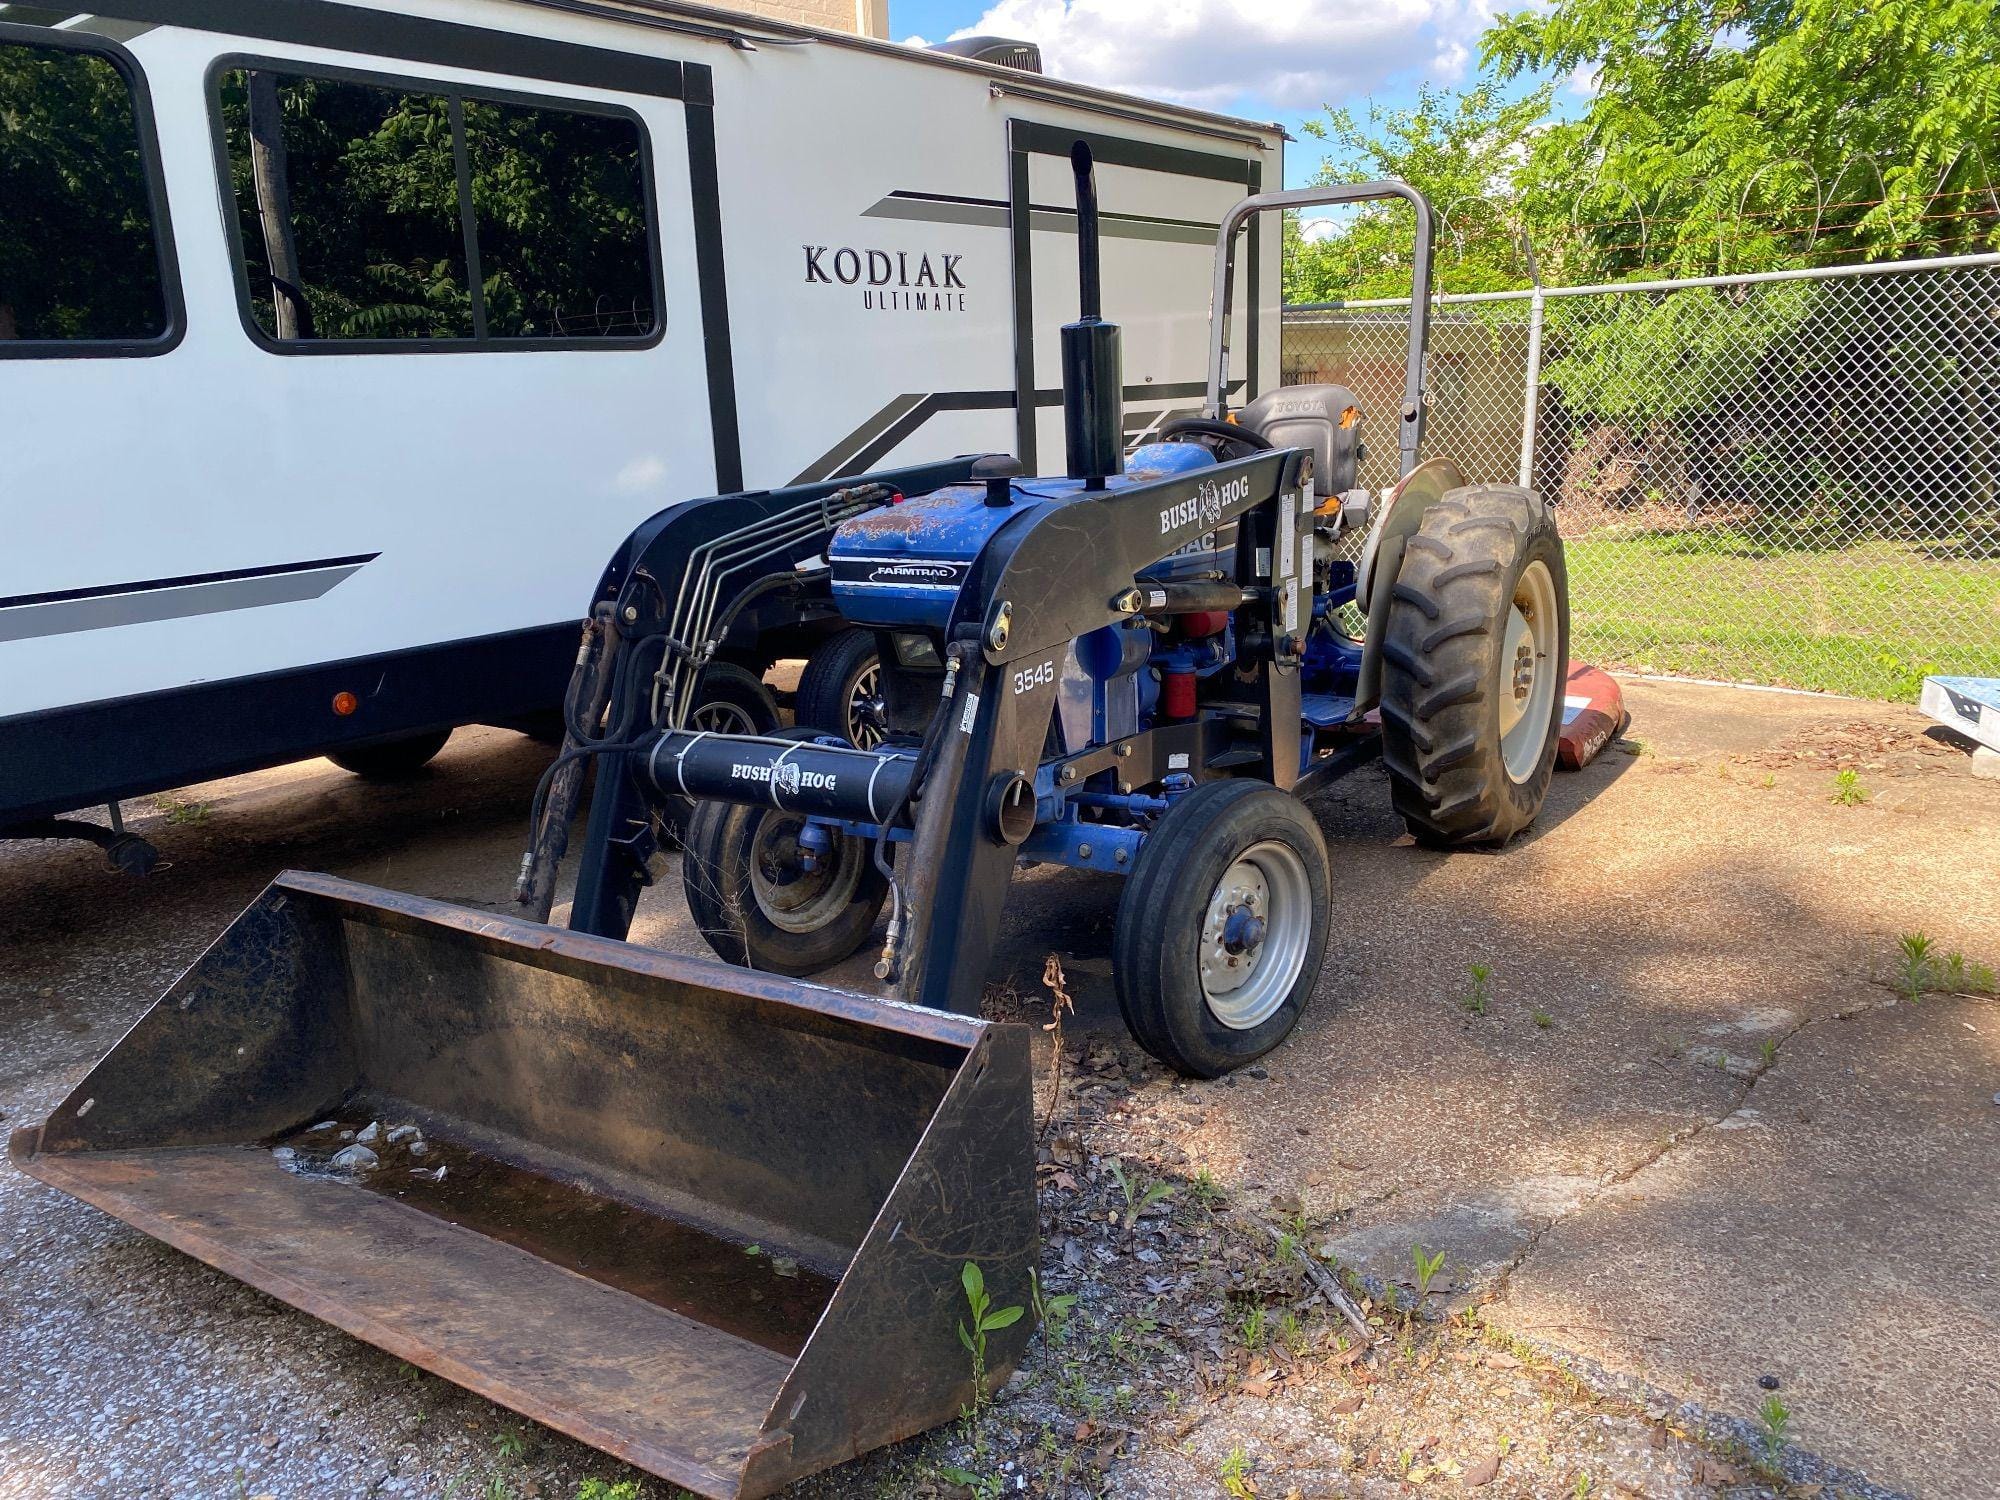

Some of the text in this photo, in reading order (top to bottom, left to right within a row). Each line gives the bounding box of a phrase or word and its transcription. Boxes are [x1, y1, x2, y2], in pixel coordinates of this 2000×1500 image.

[802, 245, 966, 288] KODIAK
[863, 291, 966, 311] ULTIMATE
[1277, 401, 1326, 413] TOYOTA
[1160, 476, 1249, 535] BUSH HOG
[877, 567, 949, 577] FARMTRAC
[1014, 660, 1054, 695] 3545
[731, 763, 837, 791] BUSH HOG
